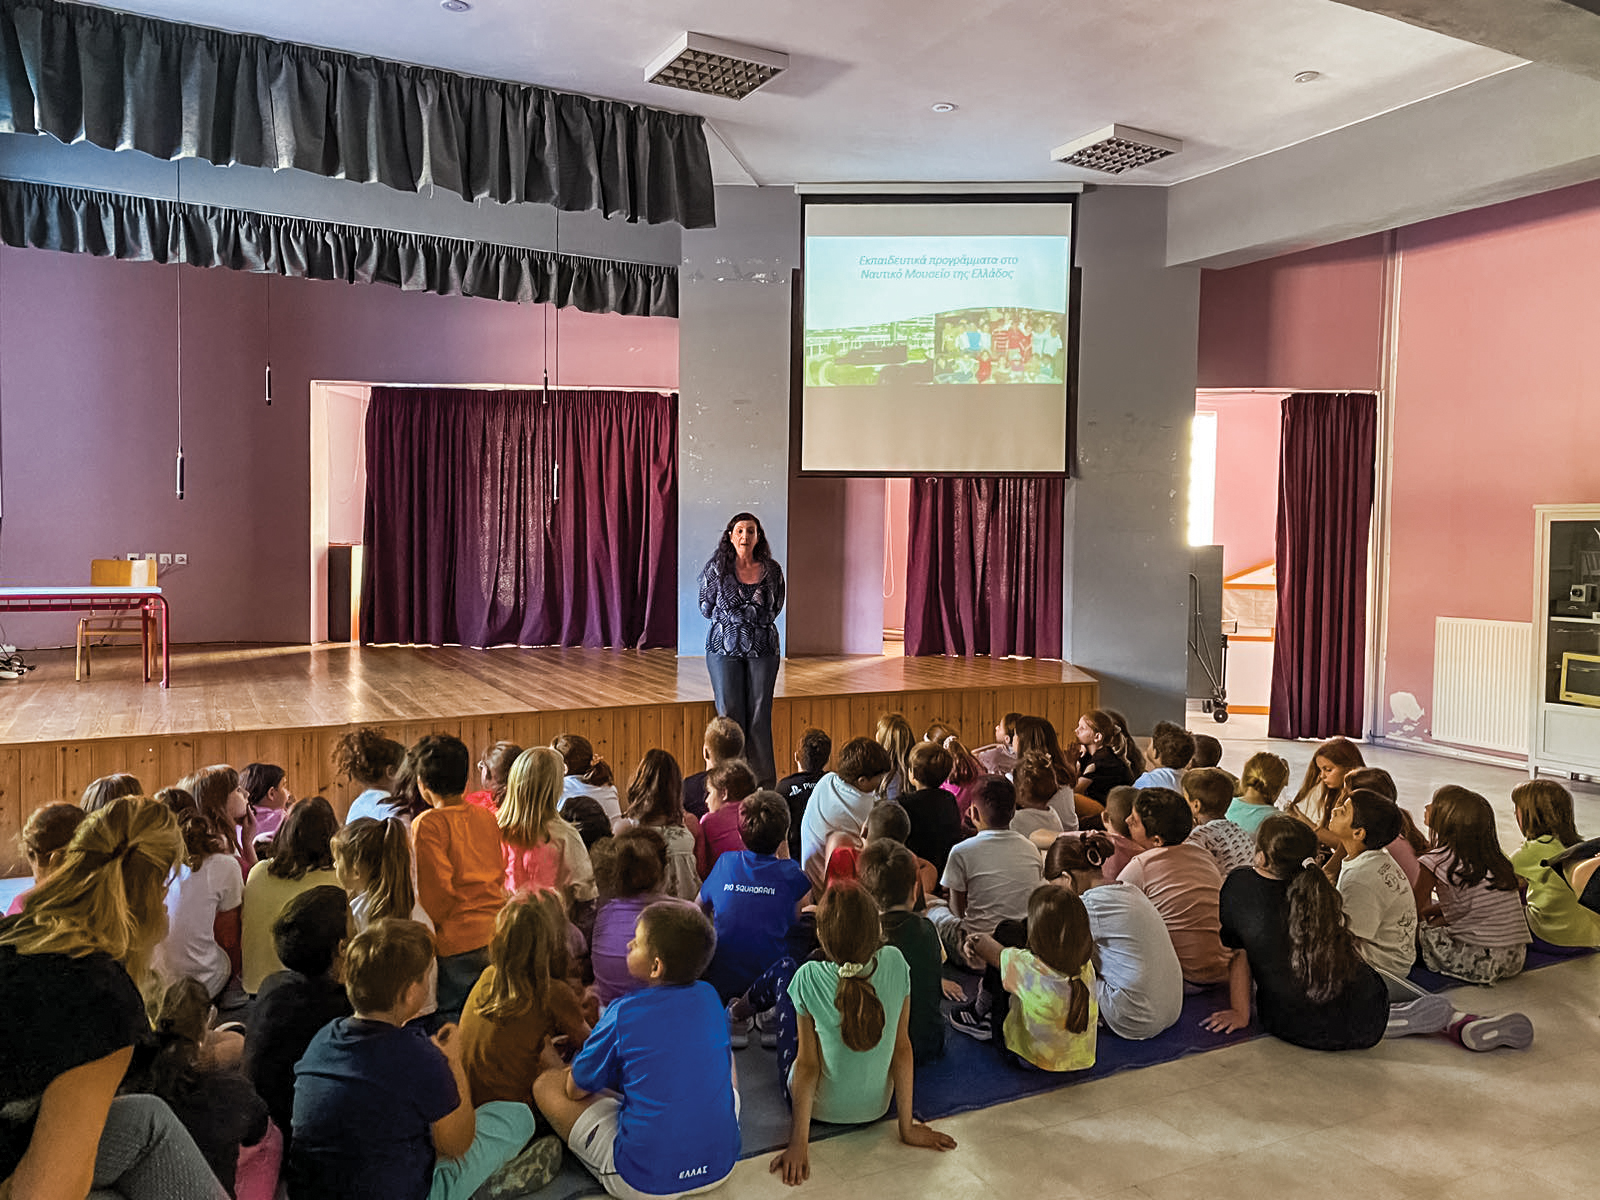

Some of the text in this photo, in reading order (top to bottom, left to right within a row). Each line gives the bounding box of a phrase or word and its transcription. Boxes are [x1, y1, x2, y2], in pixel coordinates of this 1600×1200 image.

[859, 254, 1018, 266] Εκπαιδευτικά προγράμματα στο
[861, 268, 1015, 280] Ναυτικό Μουσείο της Ελλάδος
